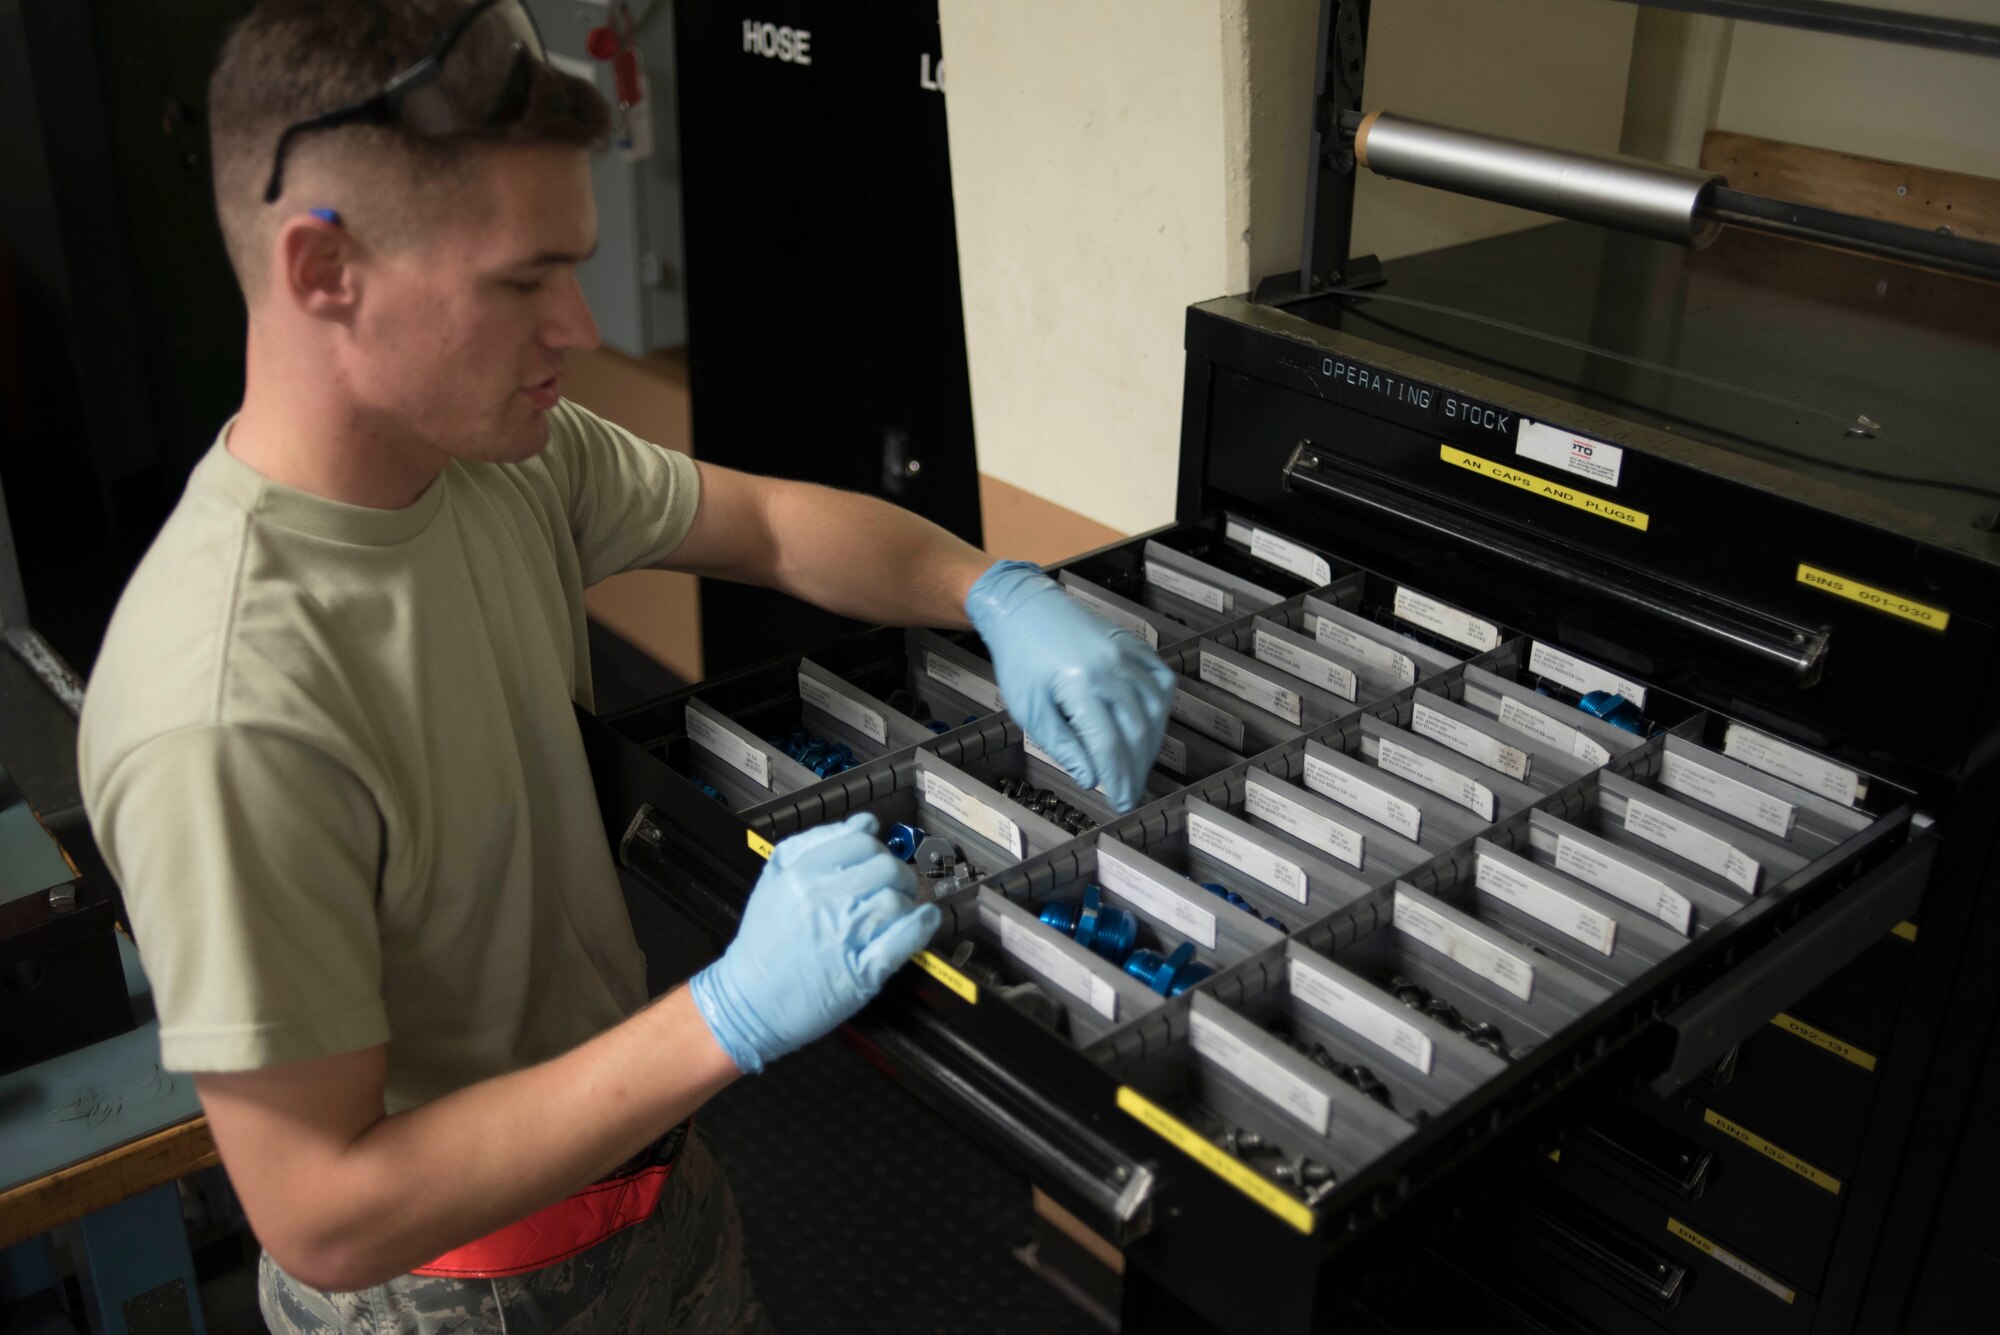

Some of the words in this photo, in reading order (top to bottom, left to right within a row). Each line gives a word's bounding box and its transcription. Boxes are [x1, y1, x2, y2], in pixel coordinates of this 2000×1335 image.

[743, 19, 812, 66] HOSE
[1322, 357, 1432, 410] OPERATING
[1445, 398, 1509, 434] STOCK
[1462, 458, 1482, 471] AN
[1492, 467, 1532, 488] CAPS
[1543, 484, 1574, 502] AND
[1585, 499, 1637, 524] PLUGS
[1803, 571, 1845, 592] BINS
[1857, 590, 1934, 622] 001-030
[1715, 1118, 1750, 1142] BINS
[1678, 1227, 1712, 1251] BINS
